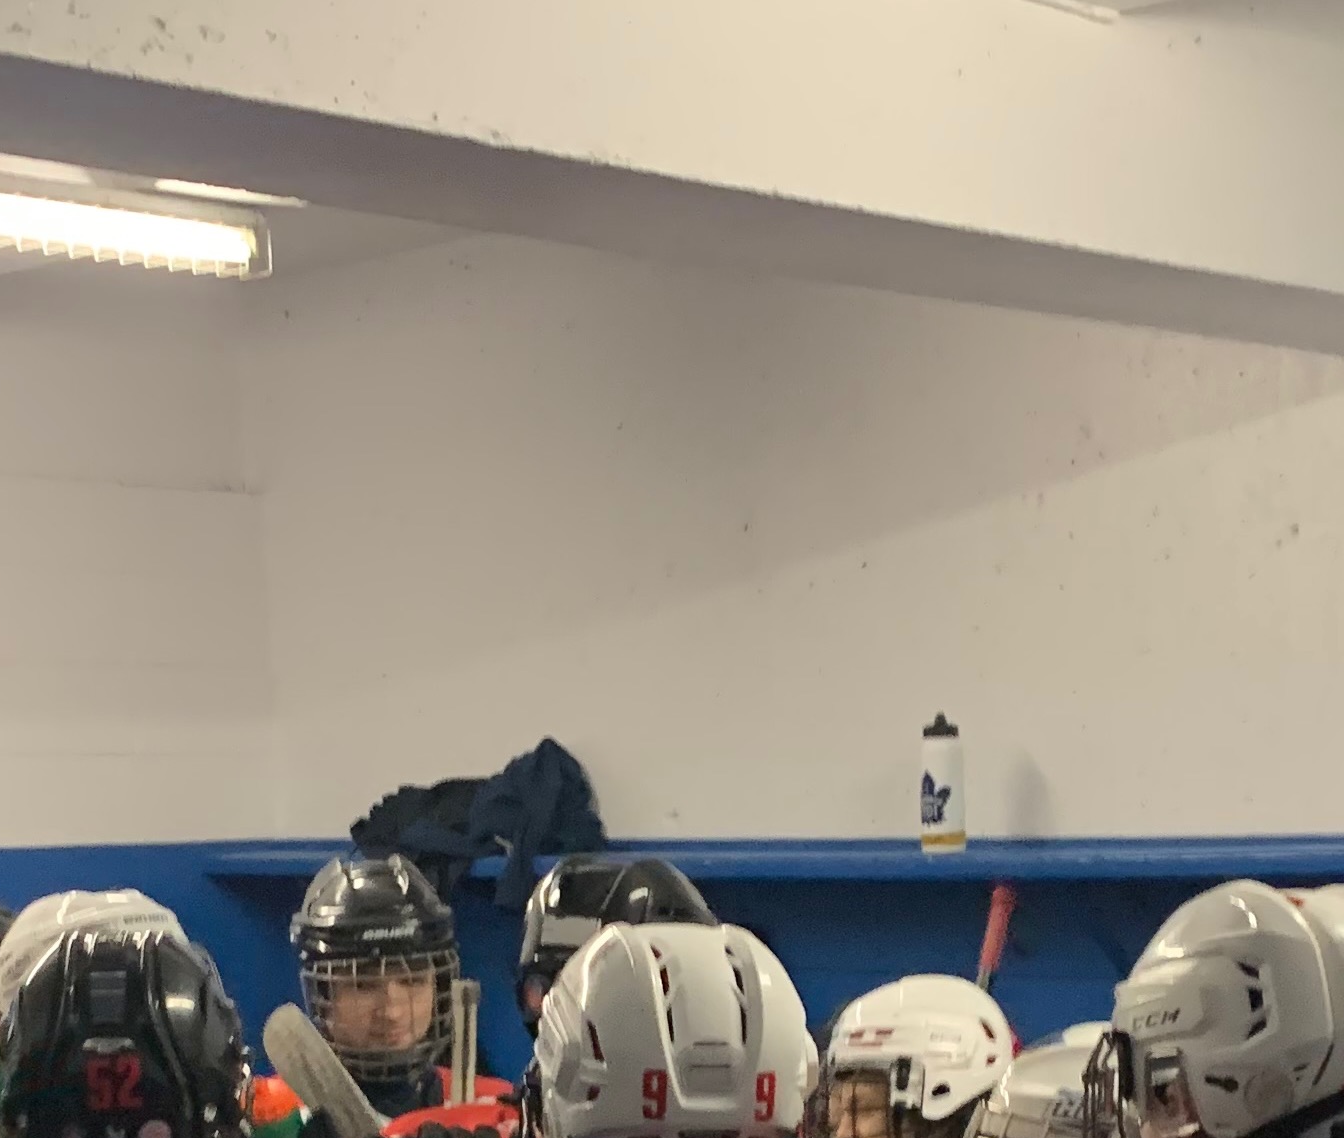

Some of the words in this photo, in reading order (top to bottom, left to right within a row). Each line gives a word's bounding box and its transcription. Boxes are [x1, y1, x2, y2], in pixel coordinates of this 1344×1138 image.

[83, 1052, 144, 1112] 52
[642, 1068, 668, 1121] 9
[754, 1070, 776, 1122] 9
